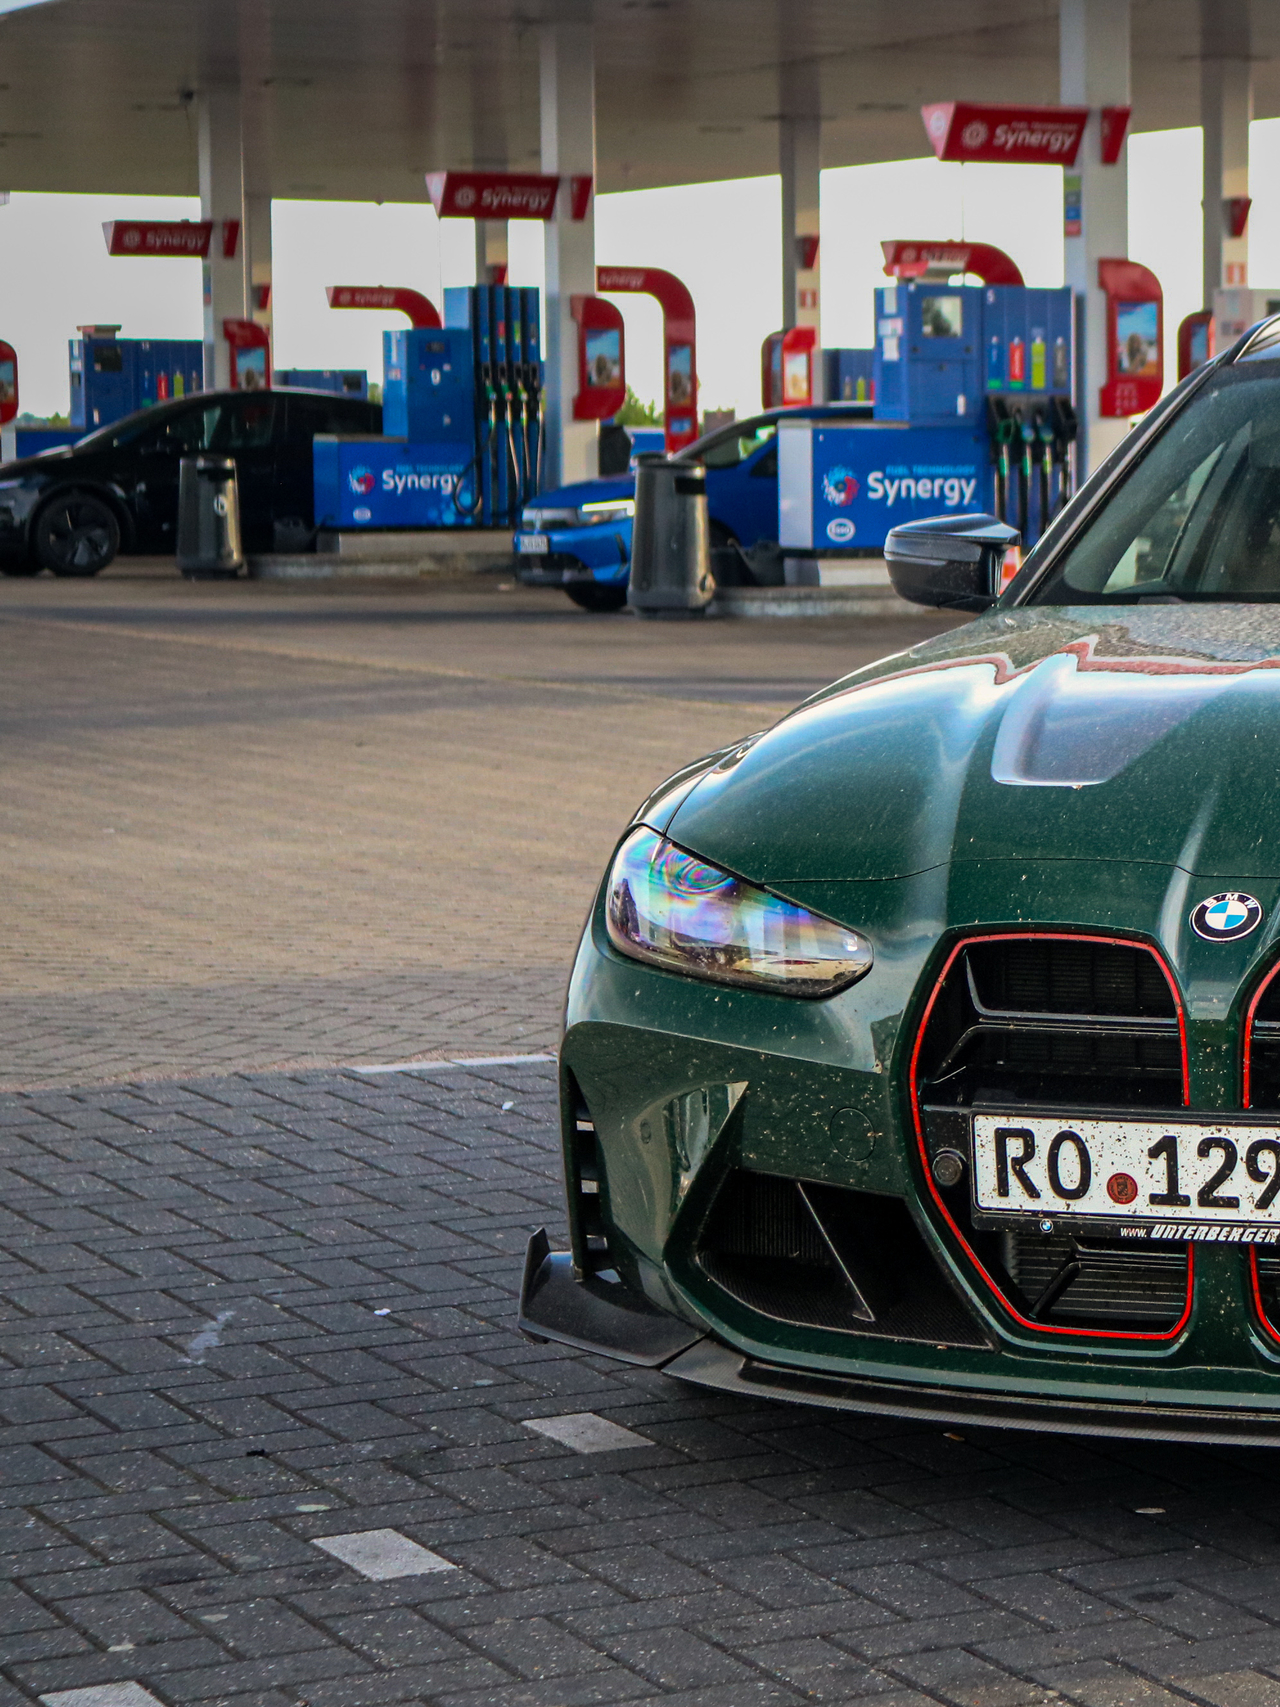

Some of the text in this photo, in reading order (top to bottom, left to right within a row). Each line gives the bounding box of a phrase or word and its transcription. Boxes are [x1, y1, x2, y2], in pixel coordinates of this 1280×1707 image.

[993, 124, 1077, 154] Synergy
[480, 188, 551, 212] Synergy
[145, 230, 205, 251] Synergy
[867, 471, 977, 507] Synergy
[1203, 893, 1258, 909] BMW
[994, 1127, 1092, 1201] RO
[1120, 1227, 1147, 1238] www.
[1150, 1224, 1280, 1243] UNTERBERGER
